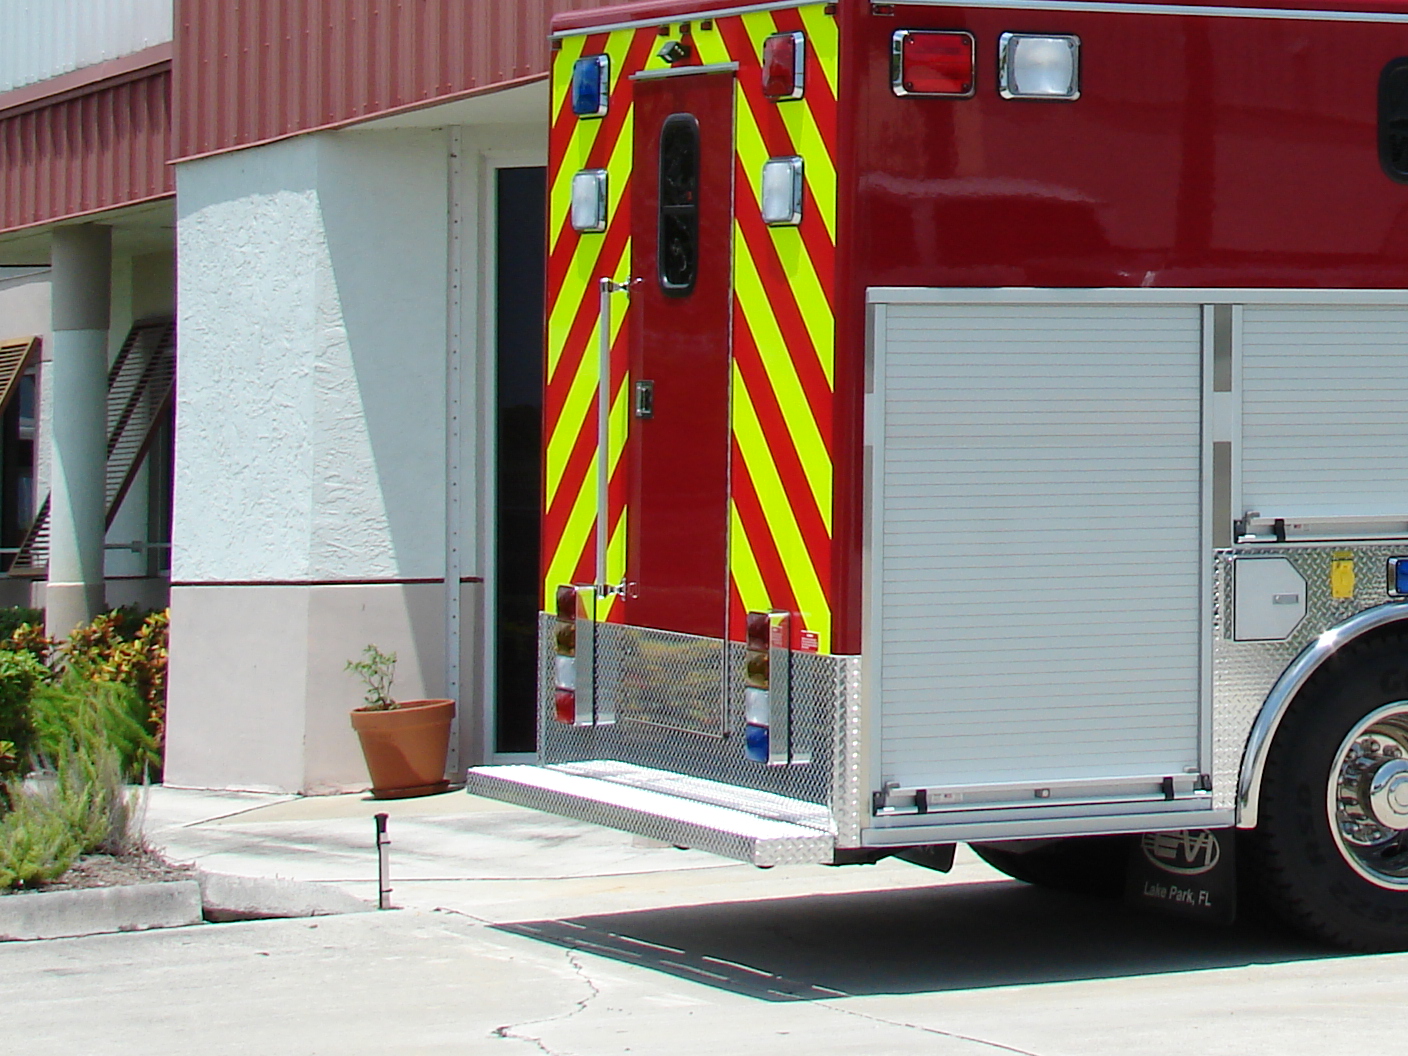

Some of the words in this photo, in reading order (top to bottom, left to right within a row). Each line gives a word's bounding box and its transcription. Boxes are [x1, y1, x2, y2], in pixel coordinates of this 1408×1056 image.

[1148, 830, 1214, 866] EVI
[1143, 881, 1167, 899] Lake
[1169, 885, 1195, 905] Park,
[1198, 890, 1211, 906] FL
